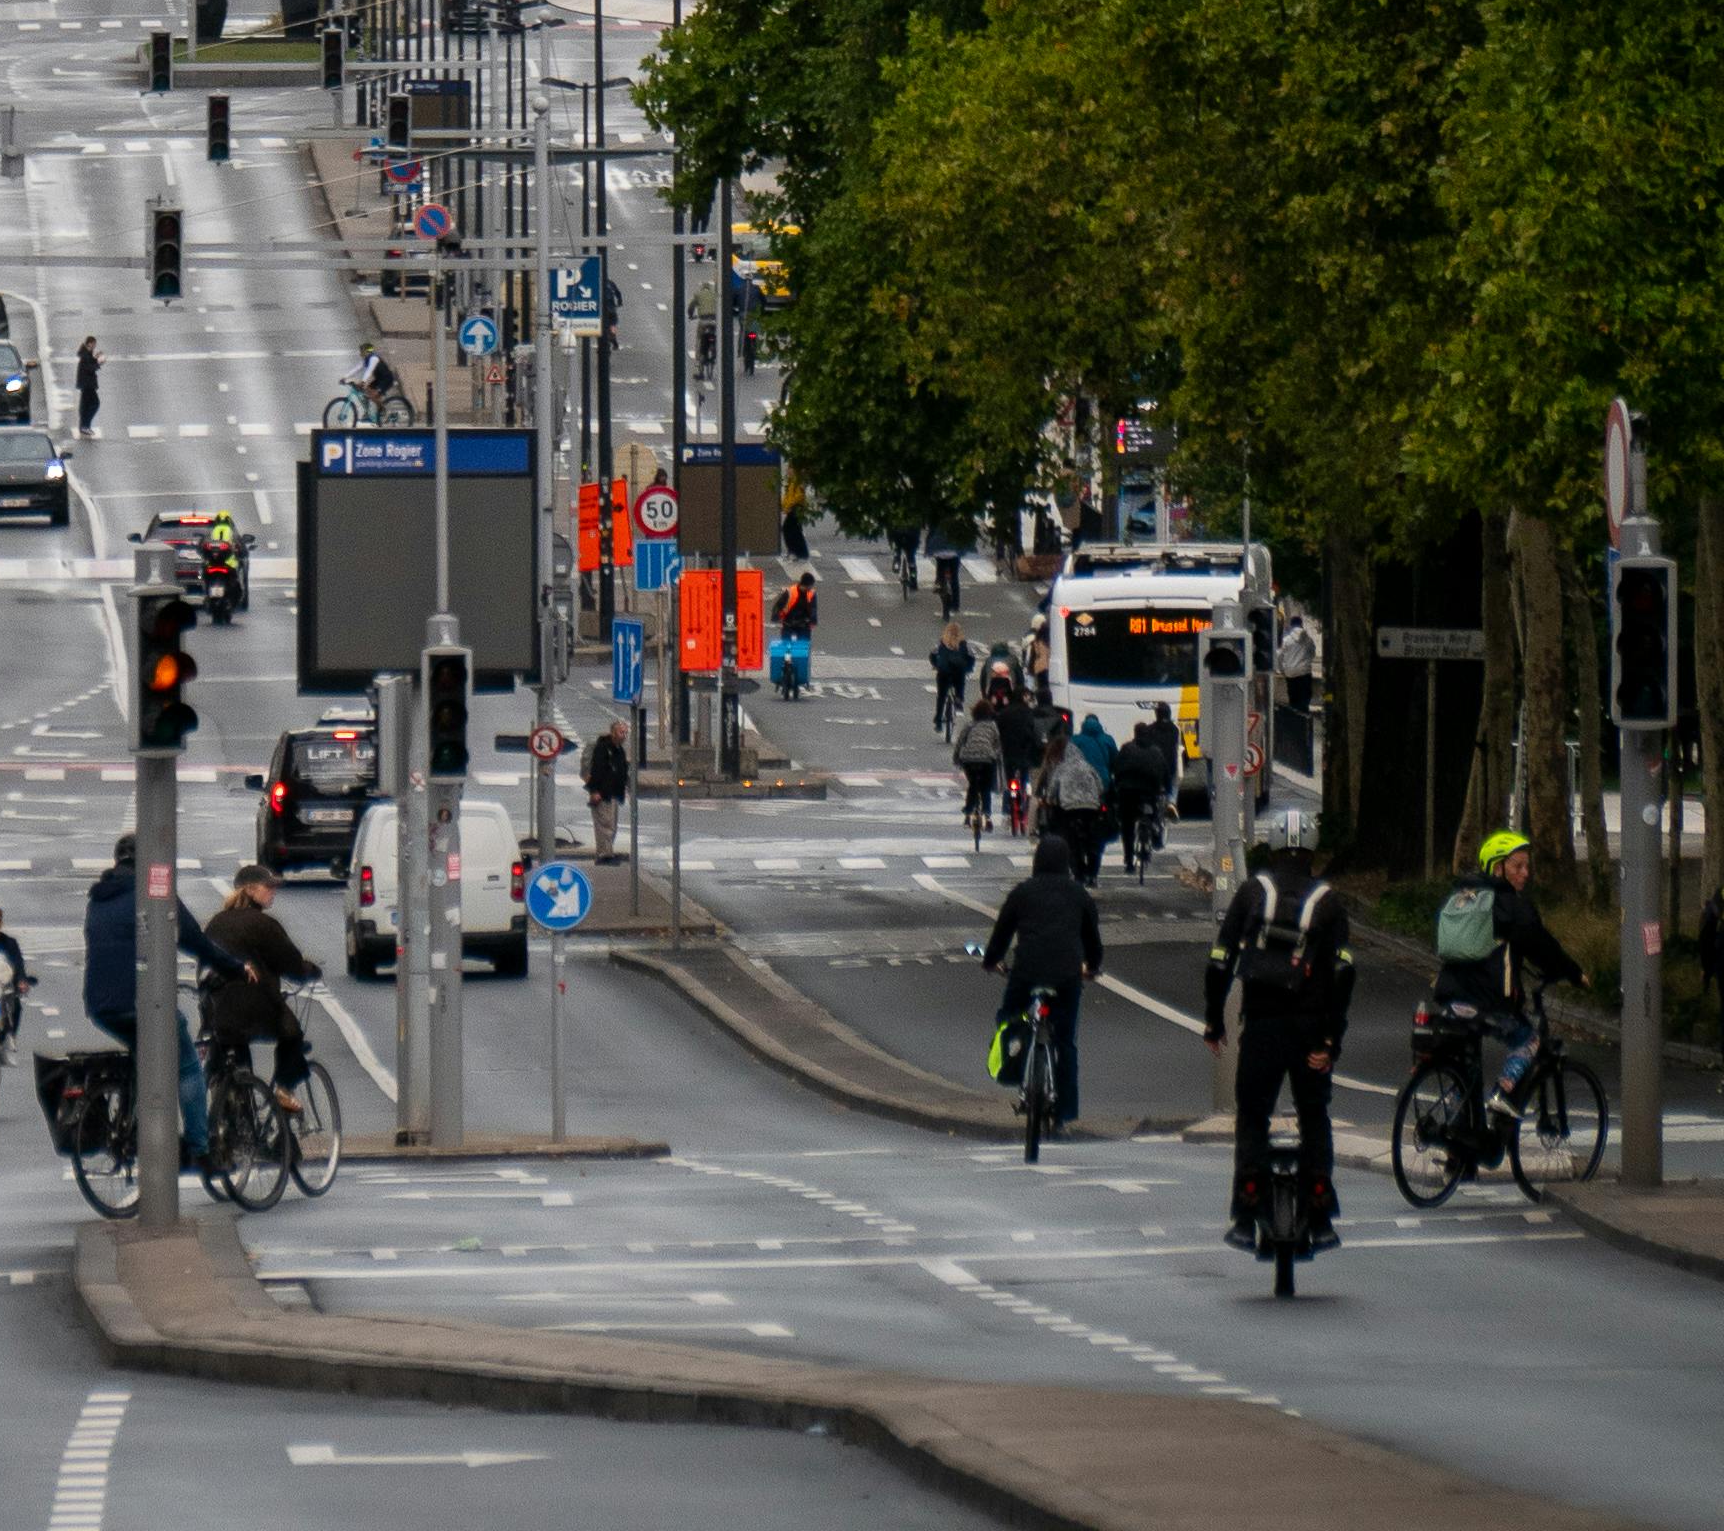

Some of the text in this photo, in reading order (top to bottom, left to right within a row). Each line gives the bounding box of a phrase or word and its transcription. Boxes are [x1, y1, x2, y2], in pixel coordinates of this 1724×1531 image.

[556, 268, 582, 299] P
[551, 300, 597, 312] ROGIER
[355, 443, 382, 458] Zone
[386, 442, 423, 461] Rogier
[646, 500, 674, 519] 50
[307, 748, 344, 760] LIFT
